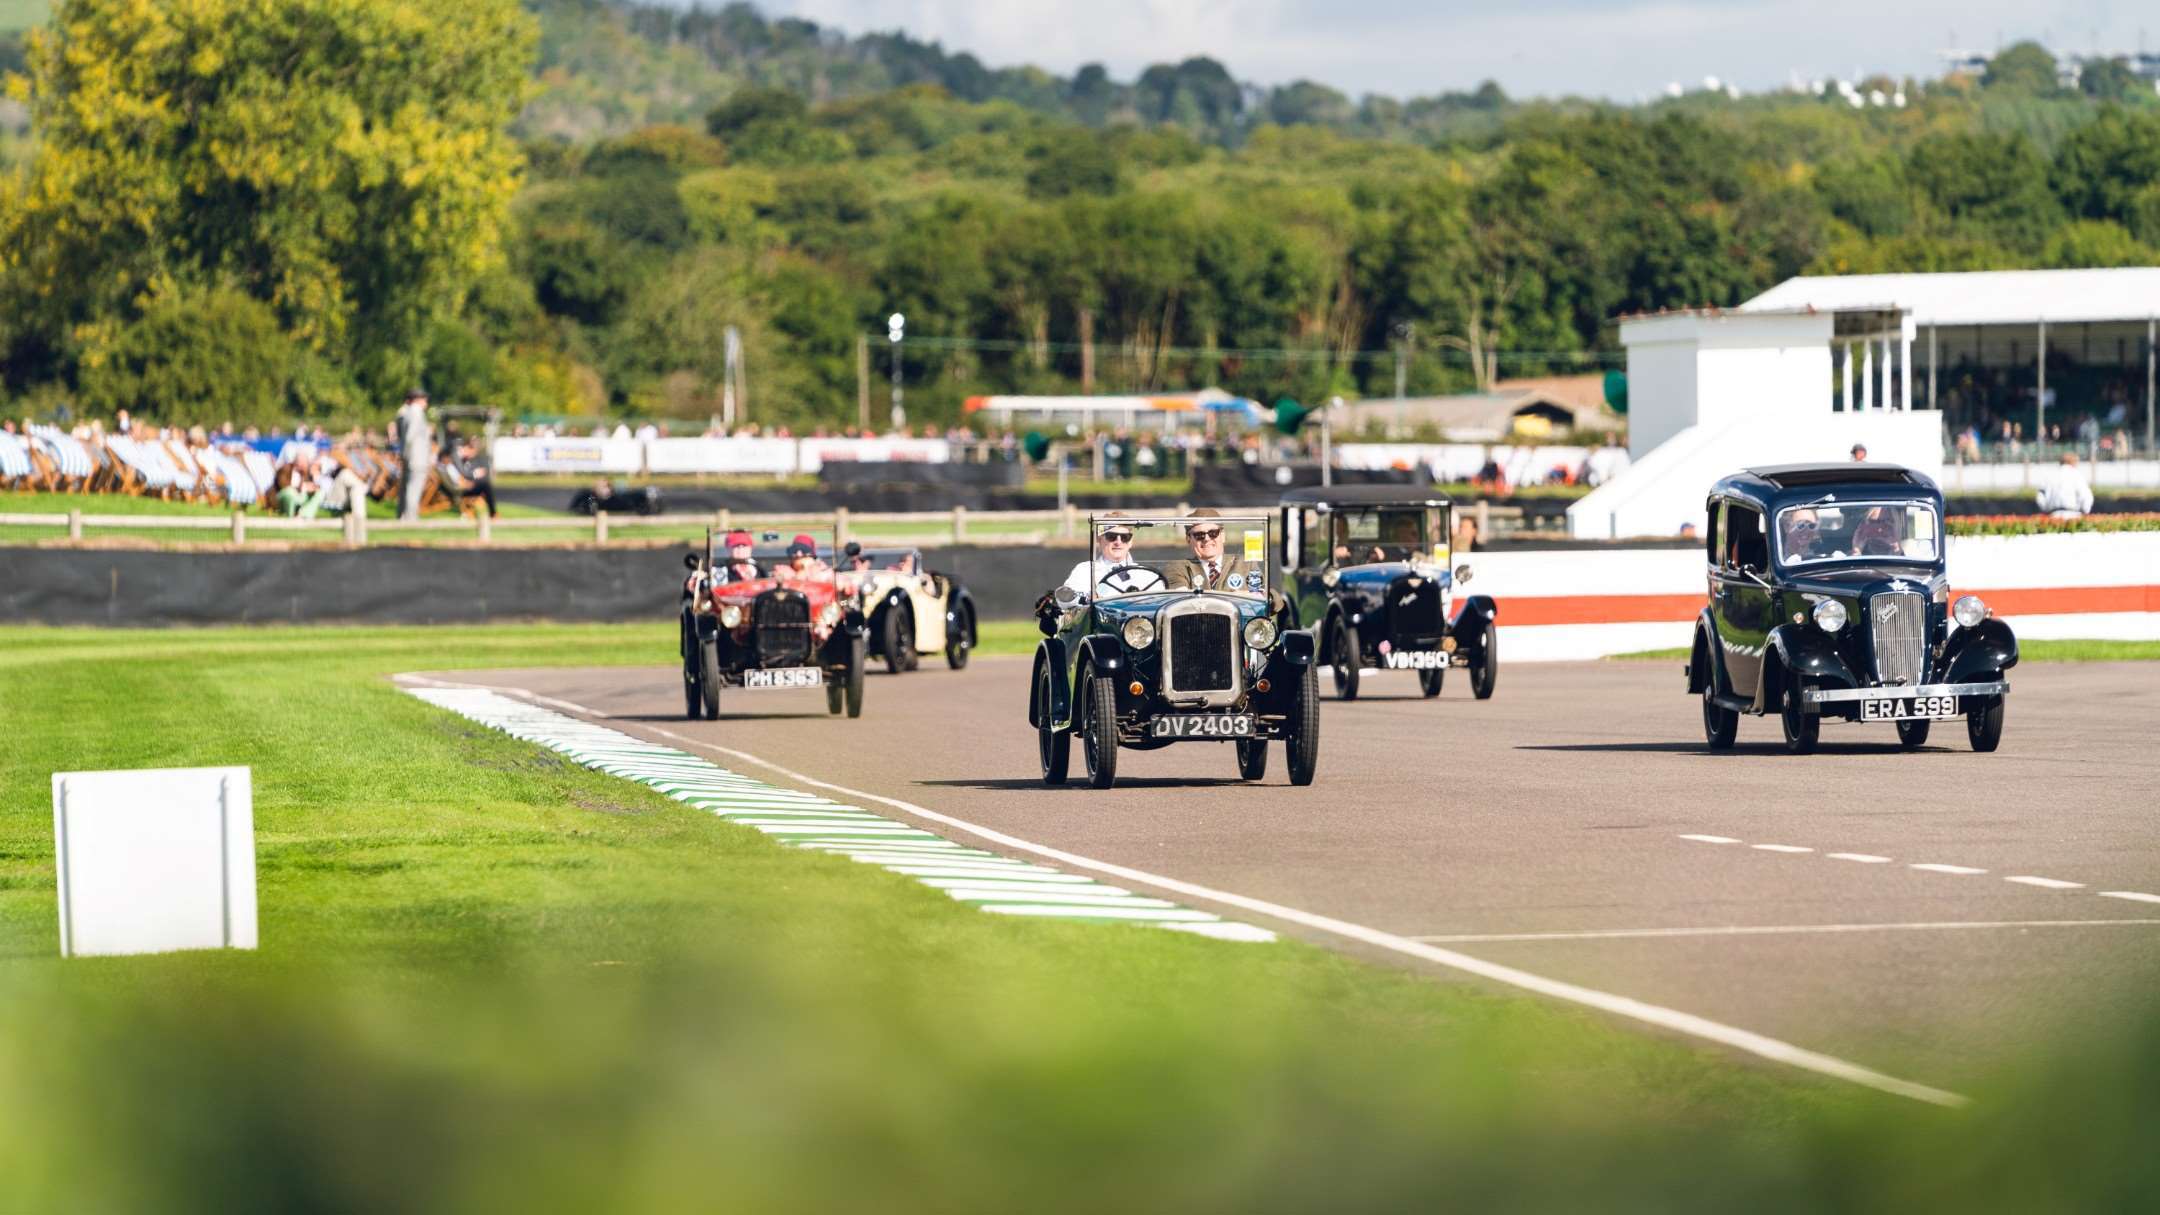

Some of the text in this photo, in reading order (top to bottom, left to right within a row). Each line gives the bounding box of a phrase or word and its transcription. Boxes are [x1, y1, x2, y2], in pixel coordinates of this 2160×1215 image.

[1865, 696, 1954, 718] ERA 599
[1156, 715, 1249, 736] DV 2403
